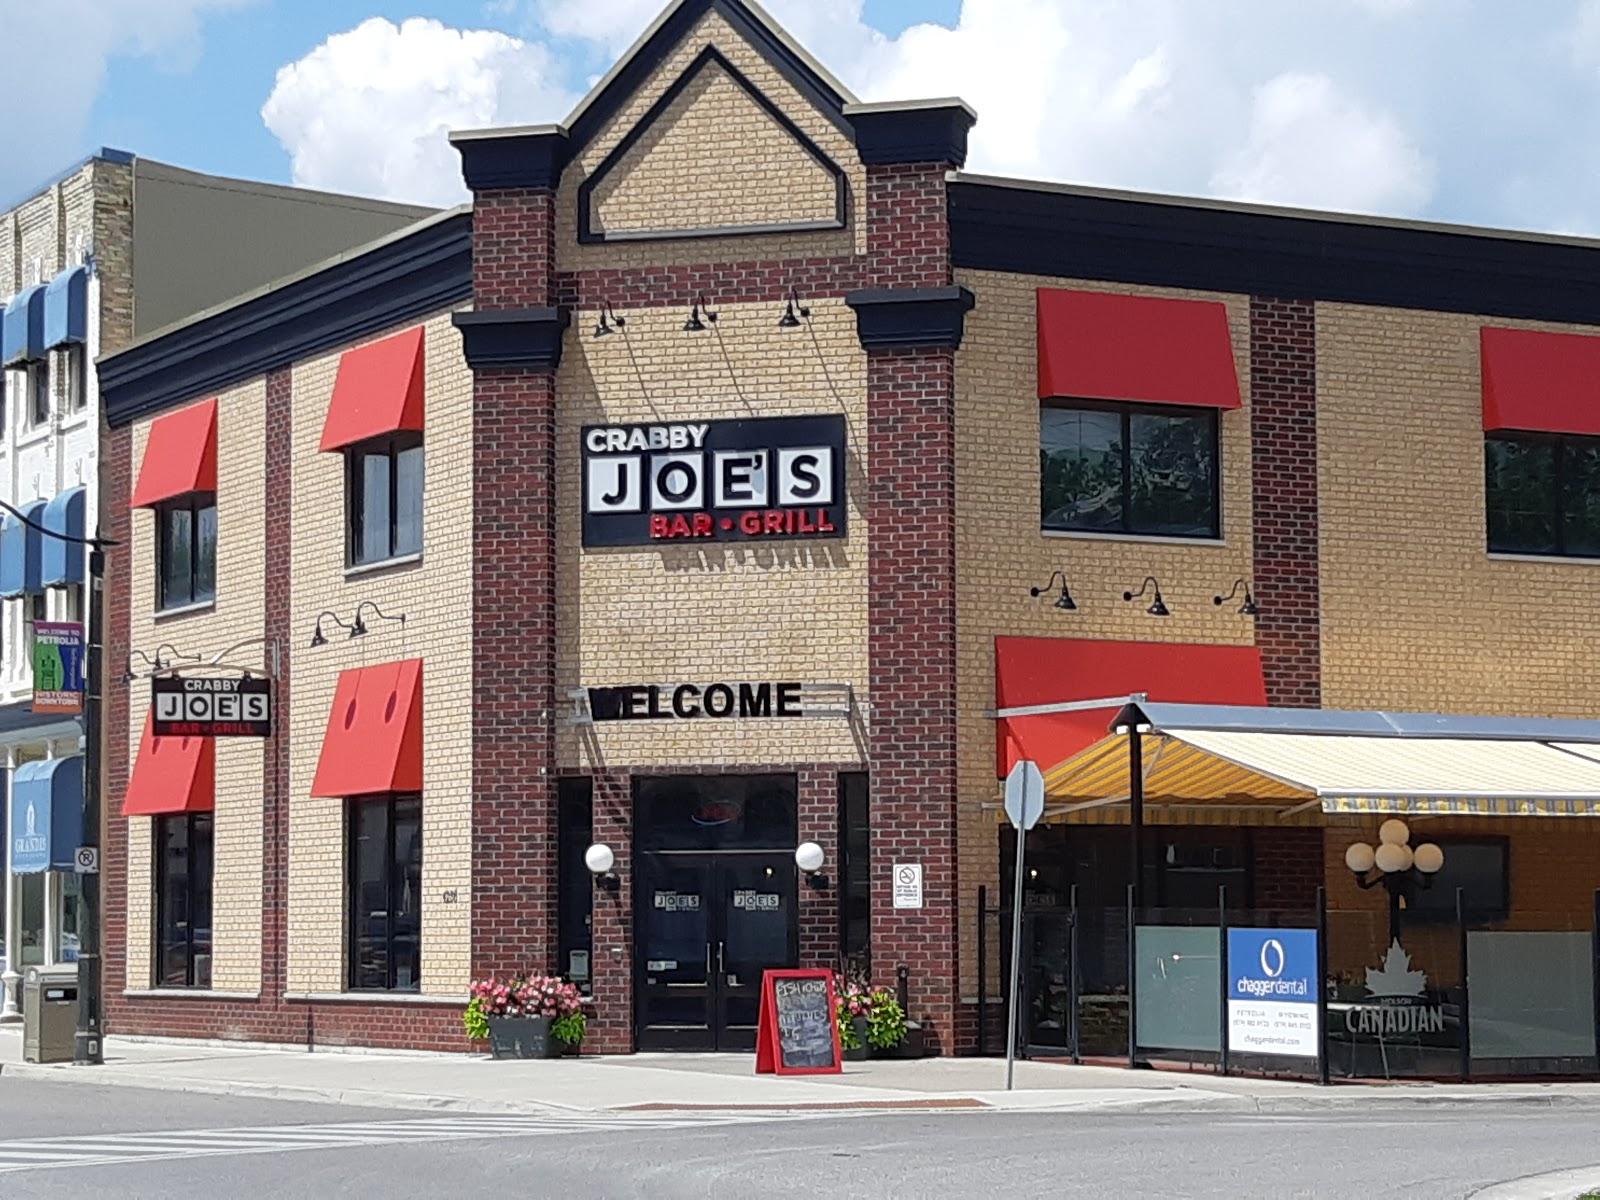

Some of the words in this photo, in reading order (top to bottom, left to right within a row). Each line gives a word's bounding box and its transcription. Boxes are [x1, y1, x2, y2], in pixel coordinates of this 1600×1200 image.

[586, 424, 709, 451] CRABBY
[600, 454, 821, 506] JOE'S
[650, 512, 713, 538] BAR
[740, 508, 836, 535] GRILL
[37, 636, 80, 645] PETROLIA
[184, 680, 240, 691] CRABBY
[164, 695, 263, 717] JOE'S
[171, 723, 200, 733] BAR
[213, 723, 254, 733] GRILL
[1346, 1005, 1443, 1032] CANADIAN
